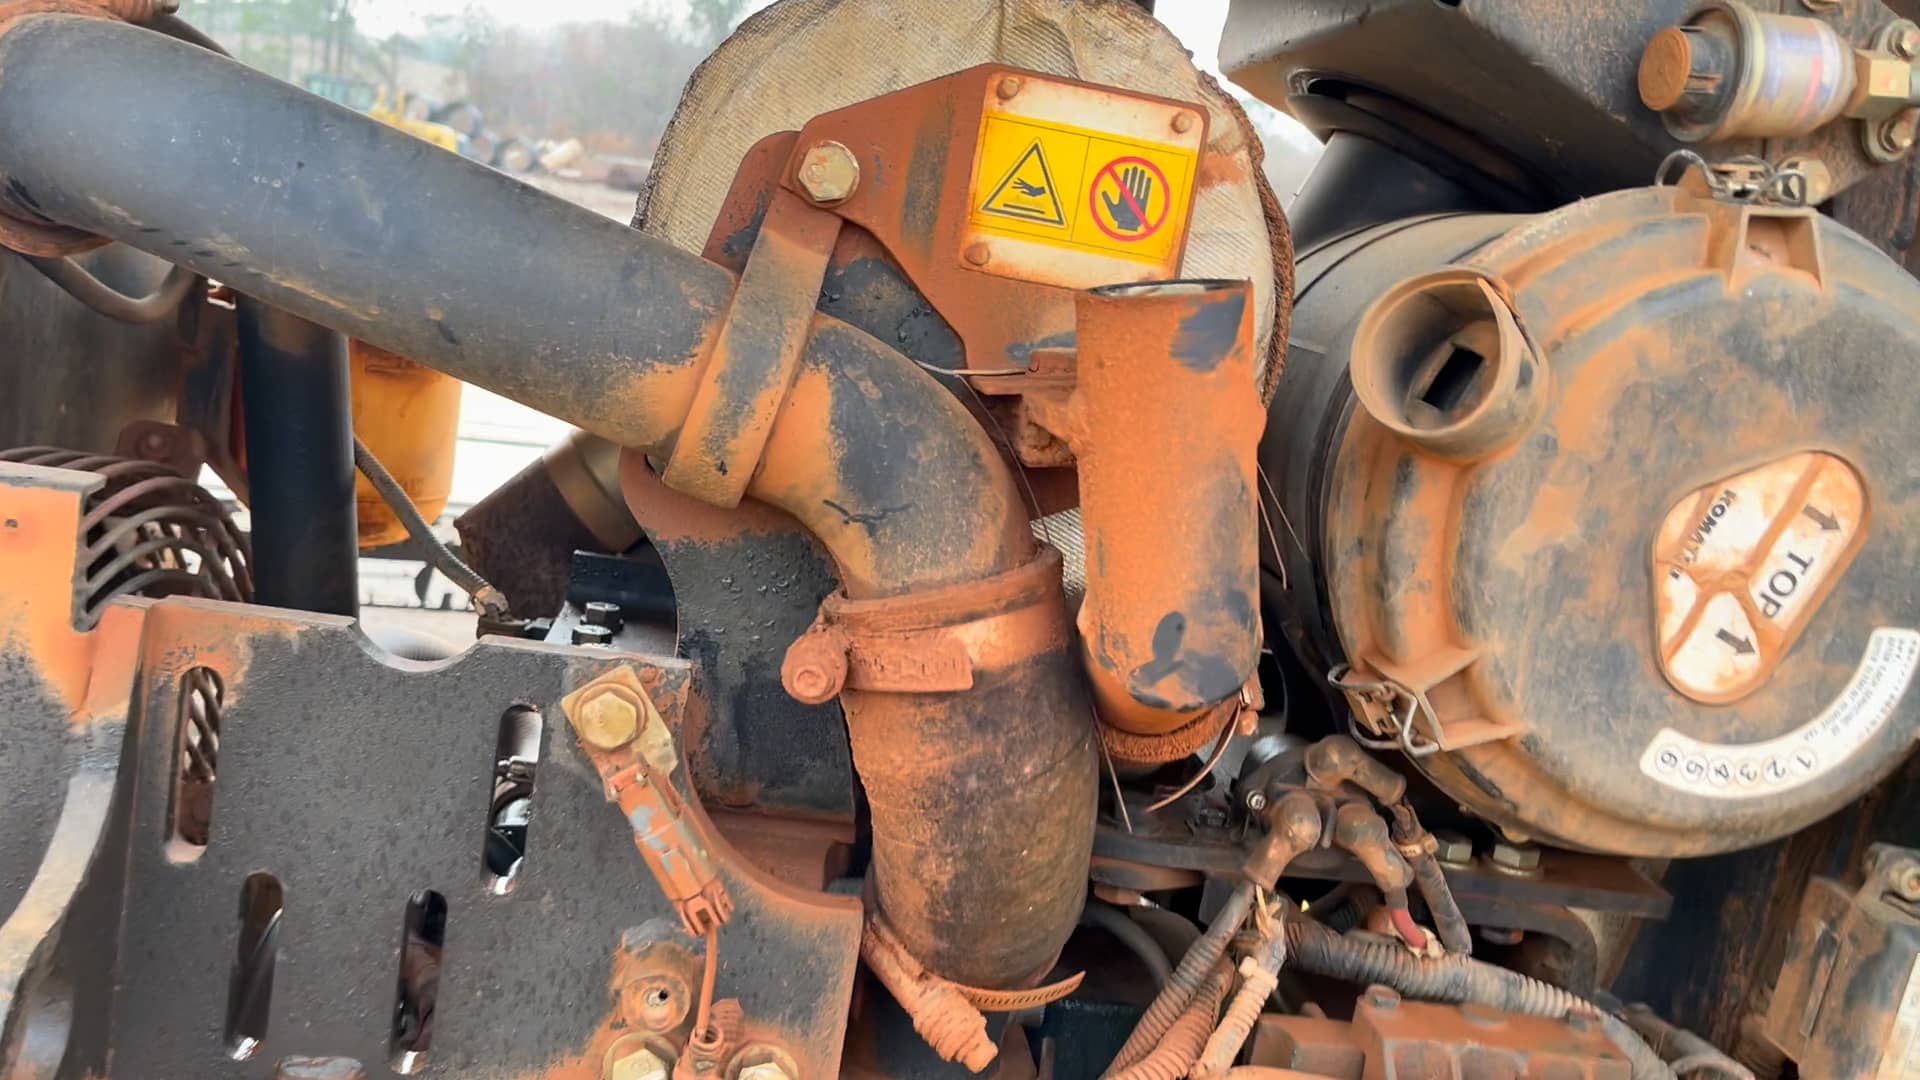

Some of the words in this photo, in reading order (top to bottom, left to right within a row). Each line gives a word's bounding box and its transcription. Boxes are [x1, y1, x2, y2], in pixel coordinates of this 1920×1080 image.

[1759, 550, 1815, 620] TOP
[1660, 751, 1678, 768] 6
[1796, 755, 1812, 769] 1
[1685, 761, 1704, 776] 5
[1714, 763, 1730, 780] 4
[1739, 762, 1758, 781] 3
[1765, 760, 1787, 779] 2
